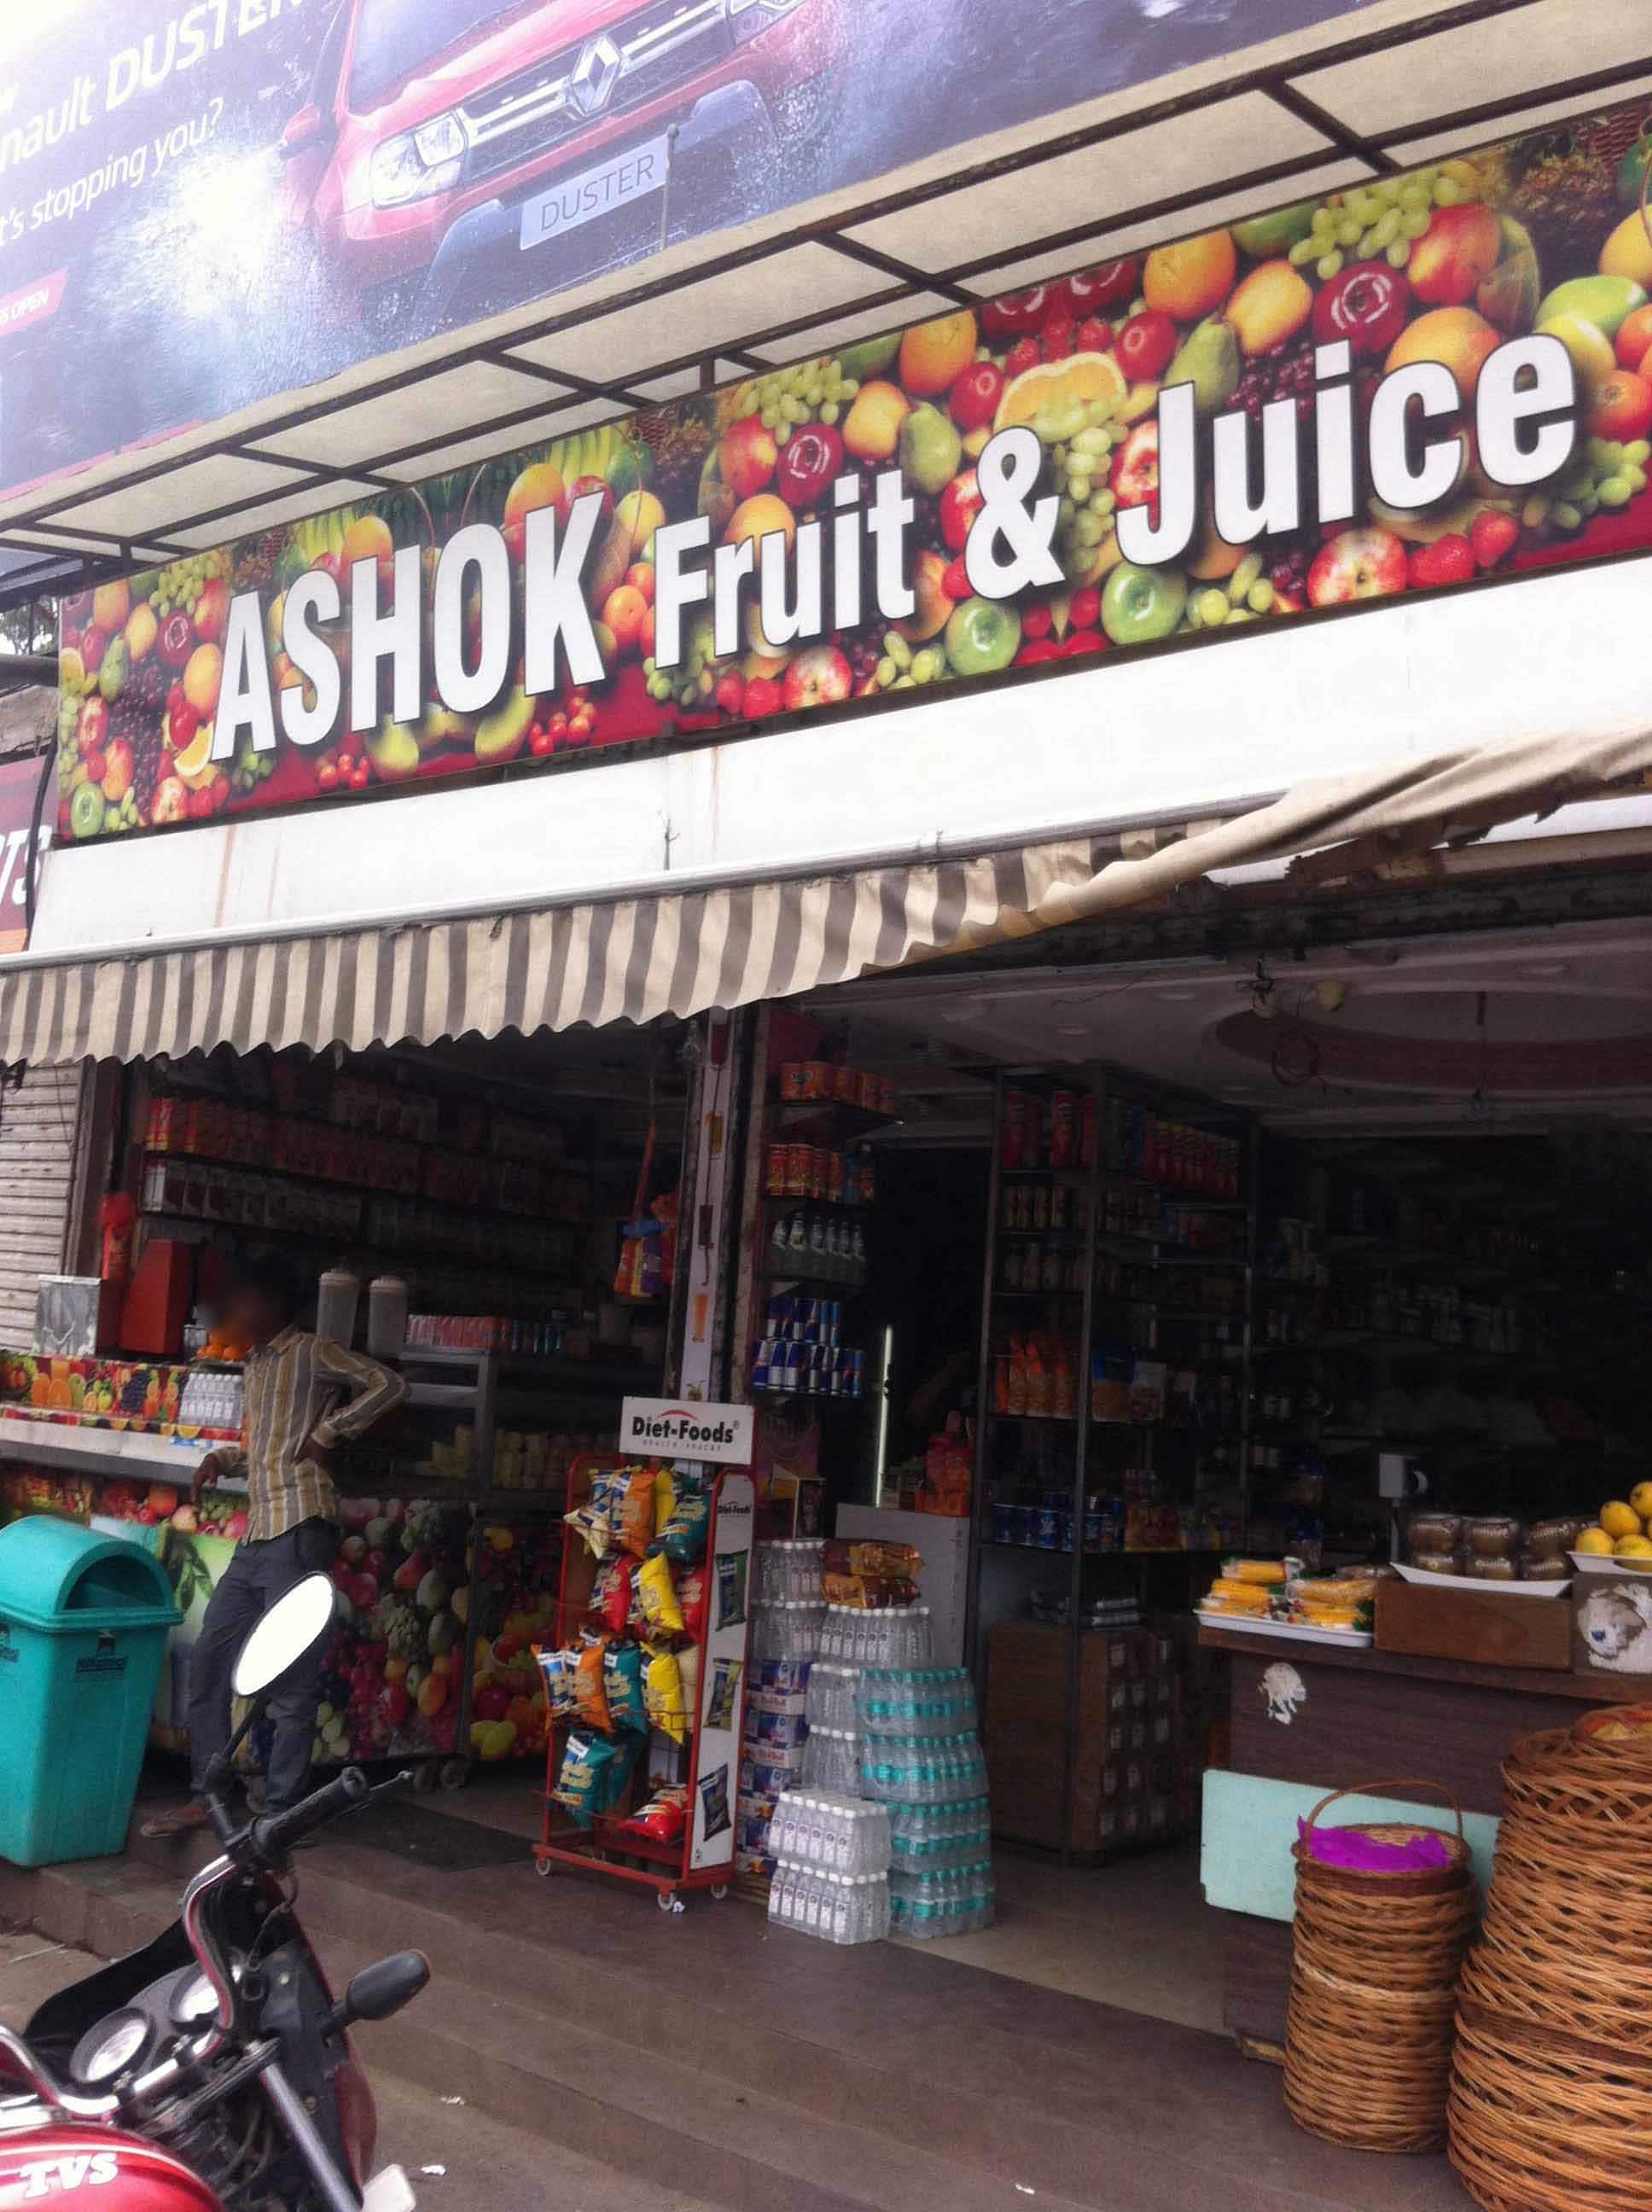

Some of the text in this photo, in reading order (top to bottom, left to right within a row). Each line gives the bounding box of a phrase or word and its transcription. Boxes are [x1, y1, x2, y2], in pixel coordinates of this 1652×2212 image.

[29, 144, 148, 222] stopping
[152, 96, 224, 178] you?
[541, 152, 654, 234] DUSTER
[211, 332, 1578, 762] ASHOK Fruit & Juice
[20, 2152, 119, 2199] TVS
